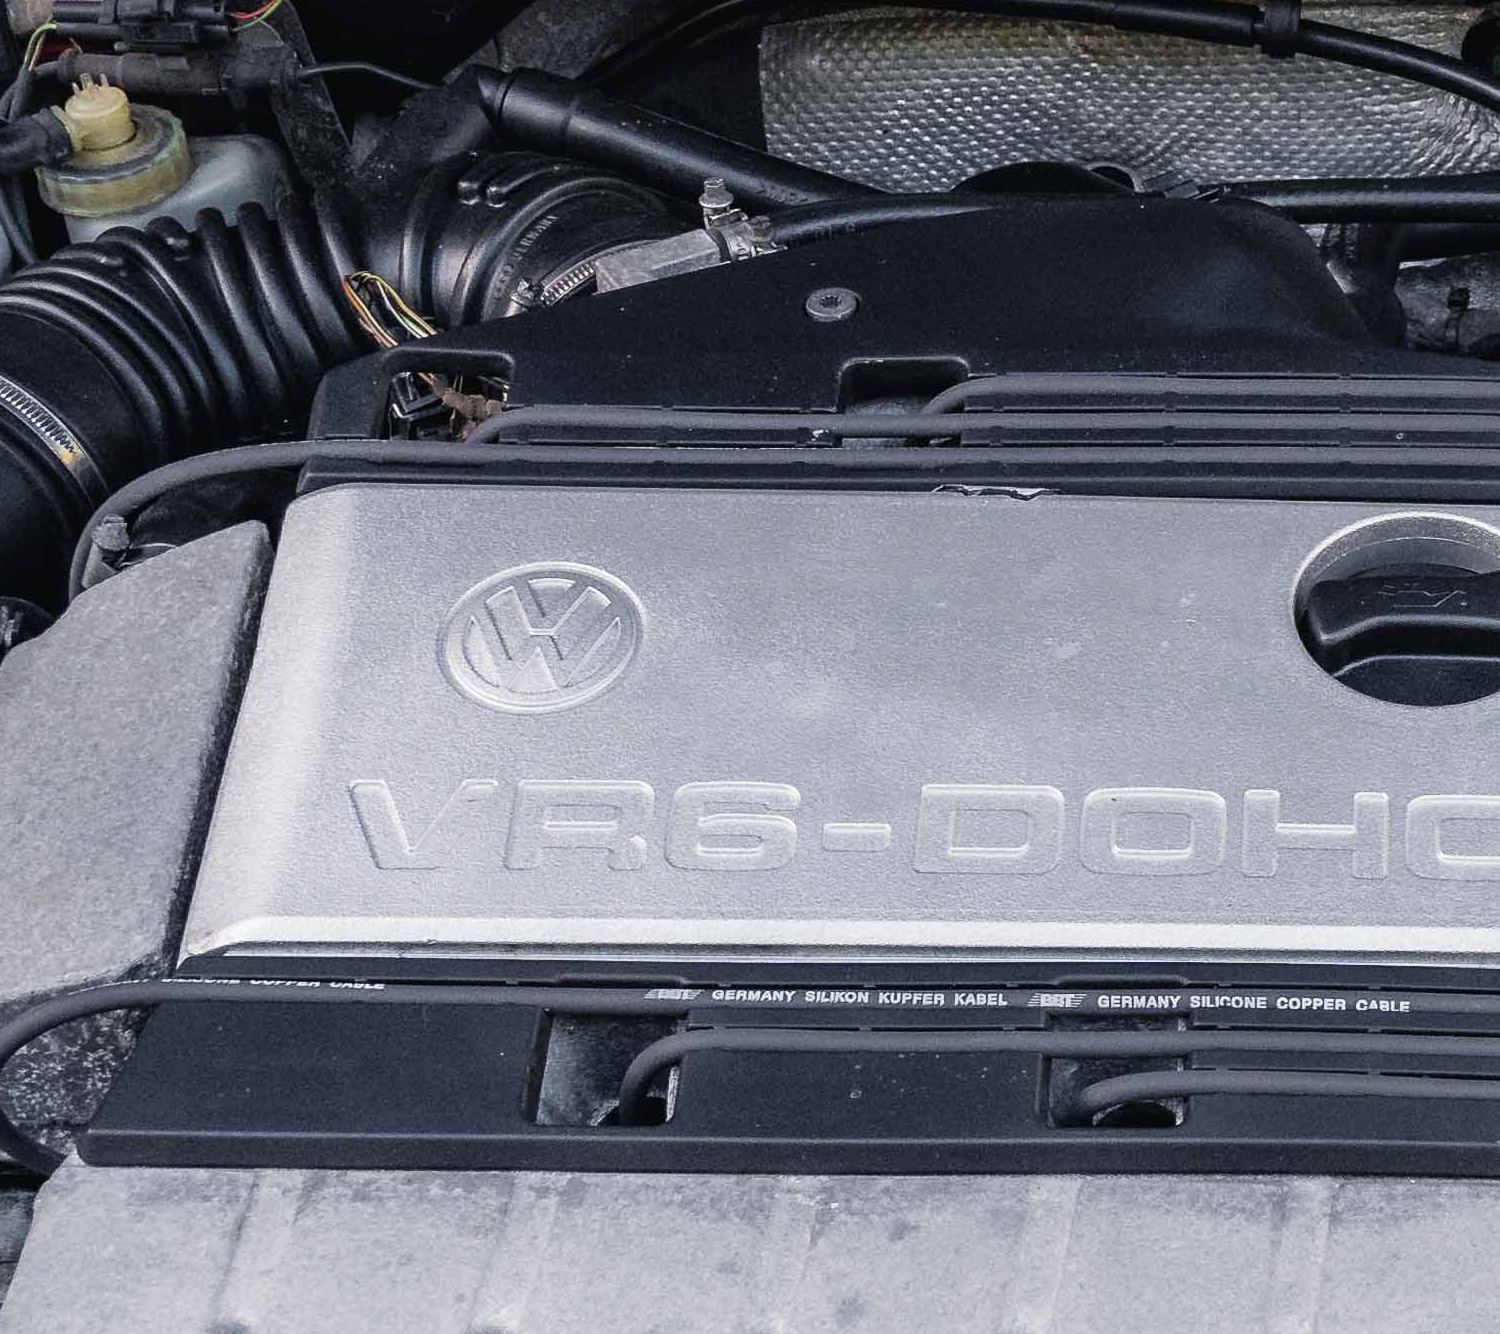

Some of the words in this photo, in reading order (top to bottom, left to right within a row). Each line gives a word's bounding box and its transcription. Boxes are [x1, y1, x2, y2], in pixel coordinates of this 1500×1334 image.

[711, 988, 796, 1004] GERMANY
[804, 989, 870, 1005] SILIKON
[878, 991, 946, 1007] KUPFER
[953, 992, 1008, 1007] KABEL
[1097, 994, 1182, 1010] GERMANY
[1189, 994, 1268, 1010] SILICONE
[1275, 996, 1347, 1012] COPPER
[1355, 998, 1412, 1014] CABLE
